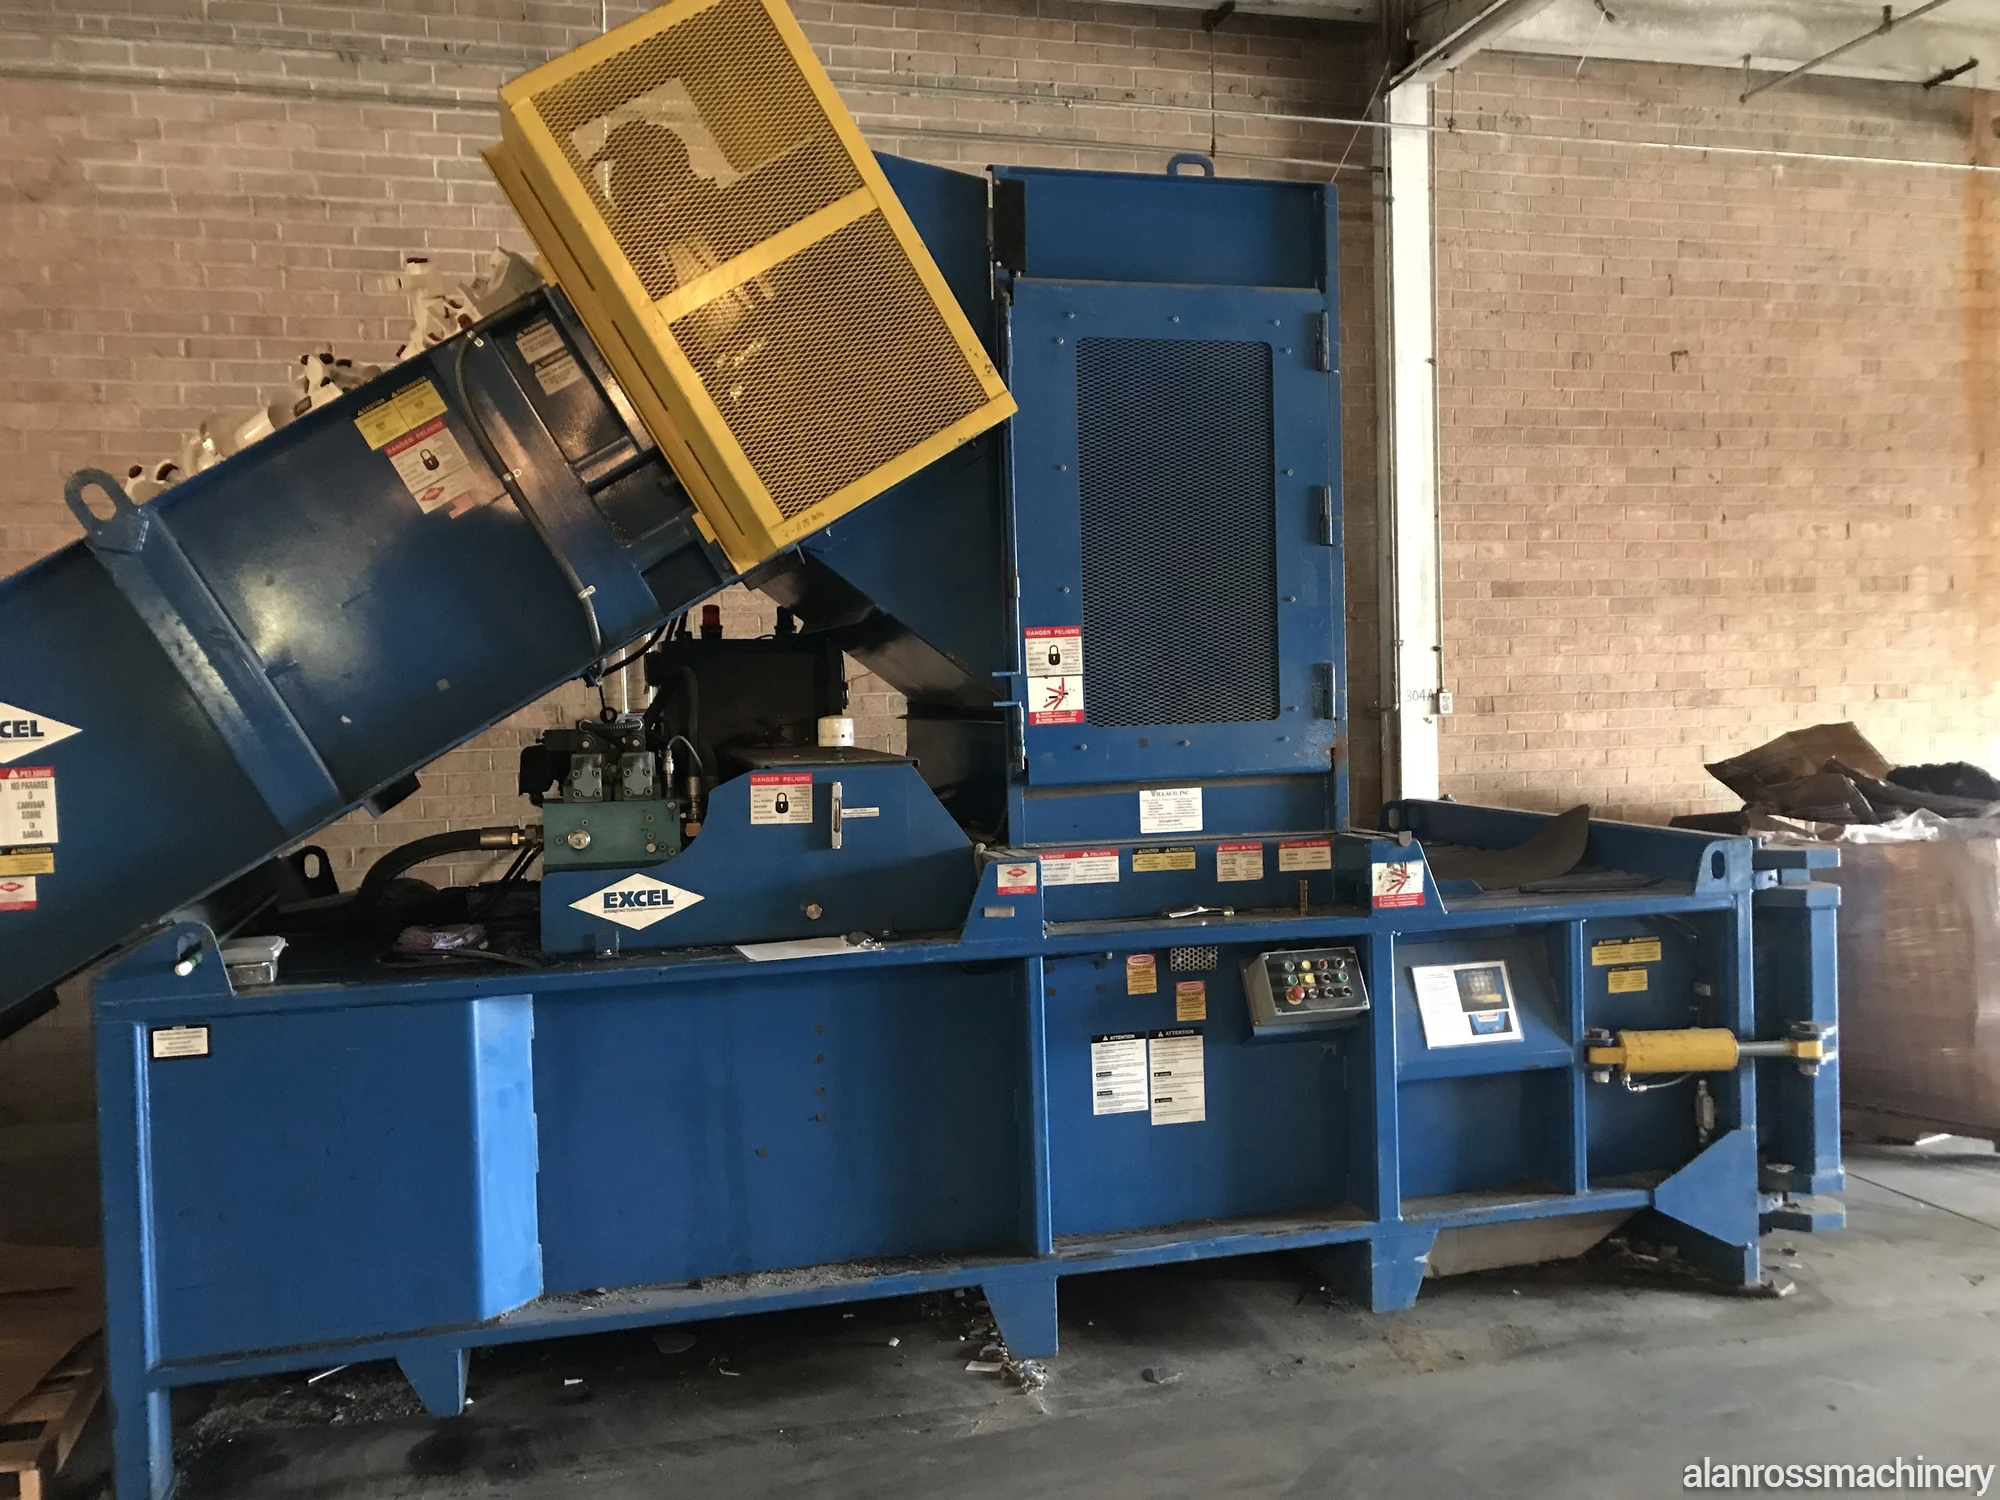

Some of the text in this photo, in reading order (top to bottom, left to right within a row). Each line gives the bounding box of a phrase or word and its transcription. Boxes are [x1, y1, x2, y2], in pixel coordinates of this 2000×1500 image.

[386, 437, 414, 455] DANGER
[416, 421, 444, 440] PELIGRO
[1405, 688, 1435, 702] 304A
[11, 781, 20, 790] NO
[21, 780, 49, 790] PARARSE
[17, 800, 45, 810] CAMINAR
[22, 810, 41, 820] SOBRE
[22, 829, 43, 839] BANDA
[603, 888, 674, 909] EXCEL
